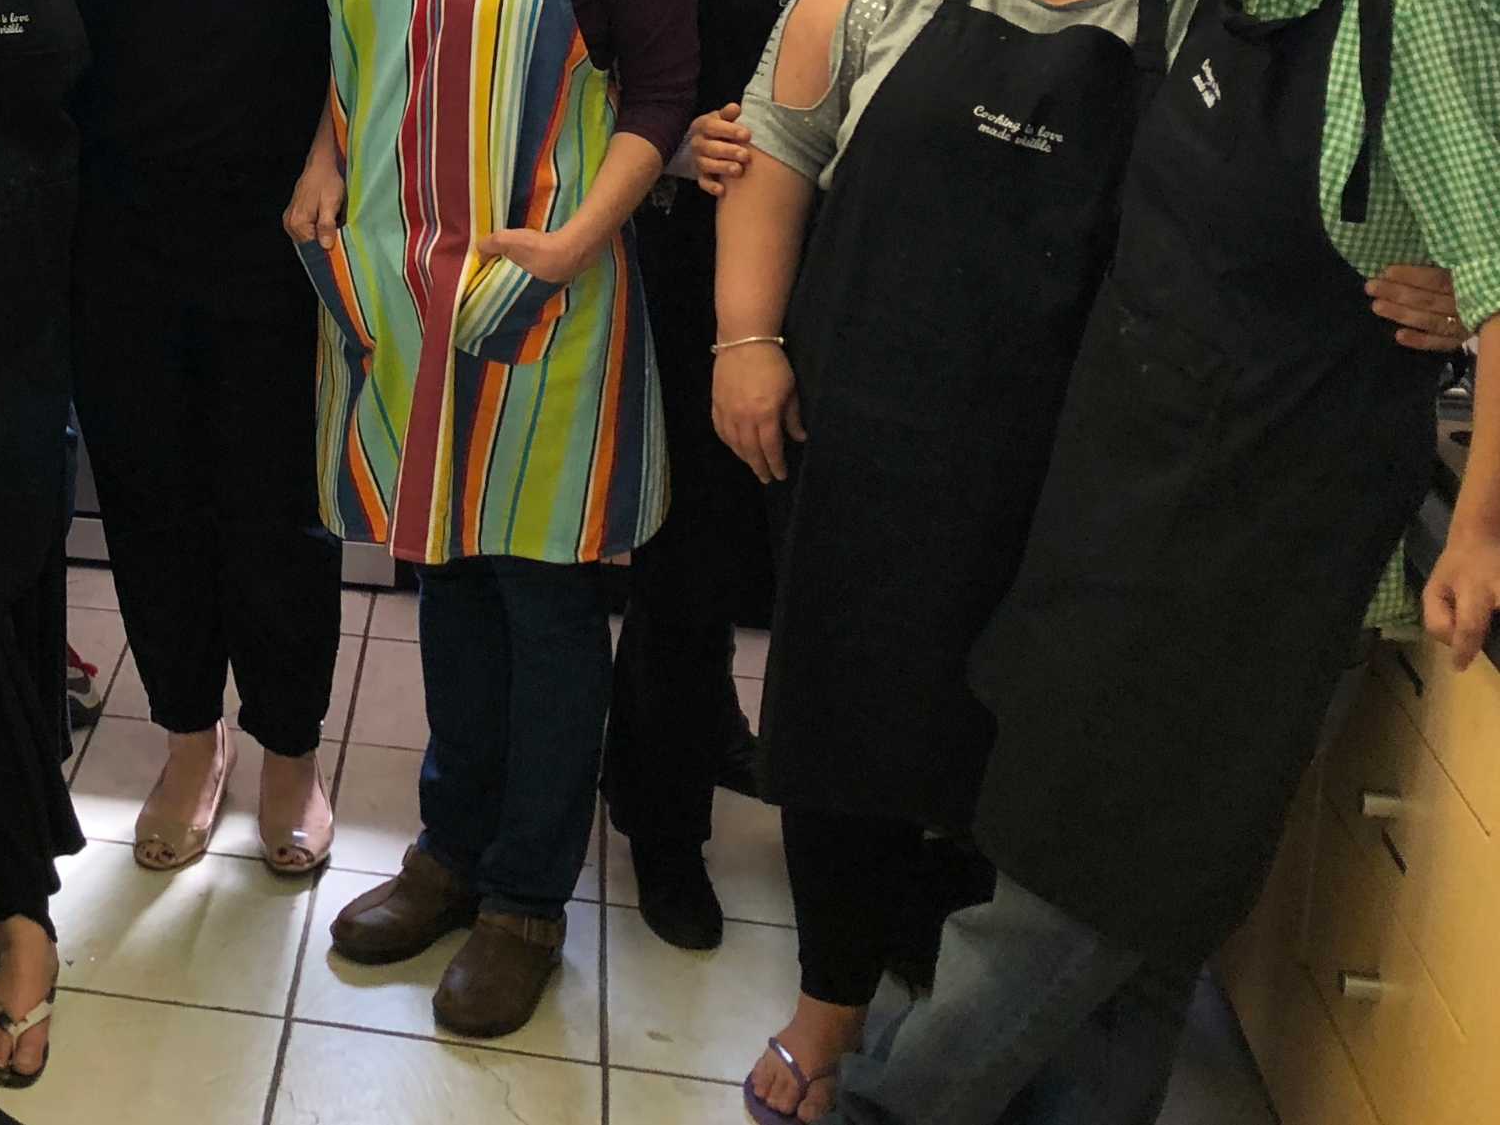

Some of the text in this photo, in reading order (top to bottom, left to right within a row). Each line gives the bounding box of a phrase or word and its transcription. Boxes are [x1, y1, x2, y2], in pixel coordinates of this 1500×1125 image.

[10, 12, 30, 23] love
[973, 105, 1064, 143] Cooking is love
[977, 123, 1052, 153] made visible
